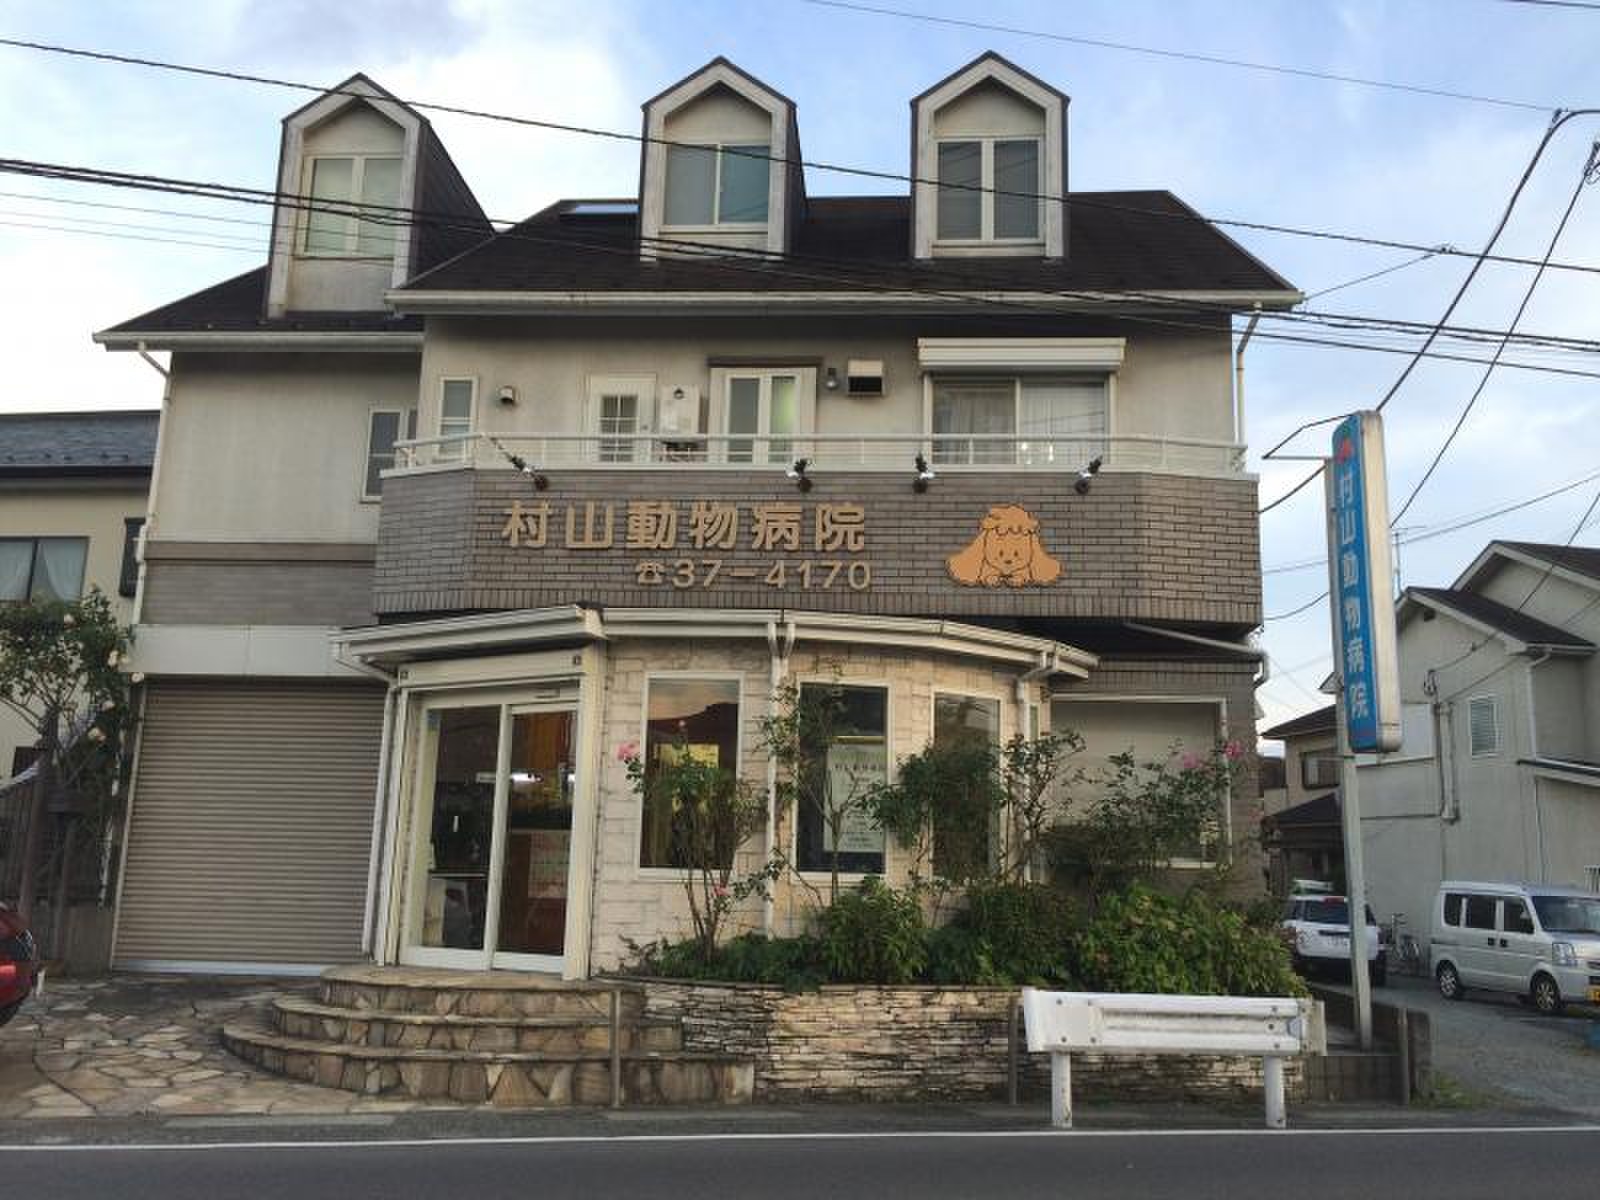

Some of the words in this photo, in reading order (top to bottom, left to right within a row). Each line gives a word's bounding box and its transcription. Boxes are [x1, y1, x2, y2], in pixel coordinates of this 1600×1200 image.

[502, 500, 866, 551] 村山動物病院
